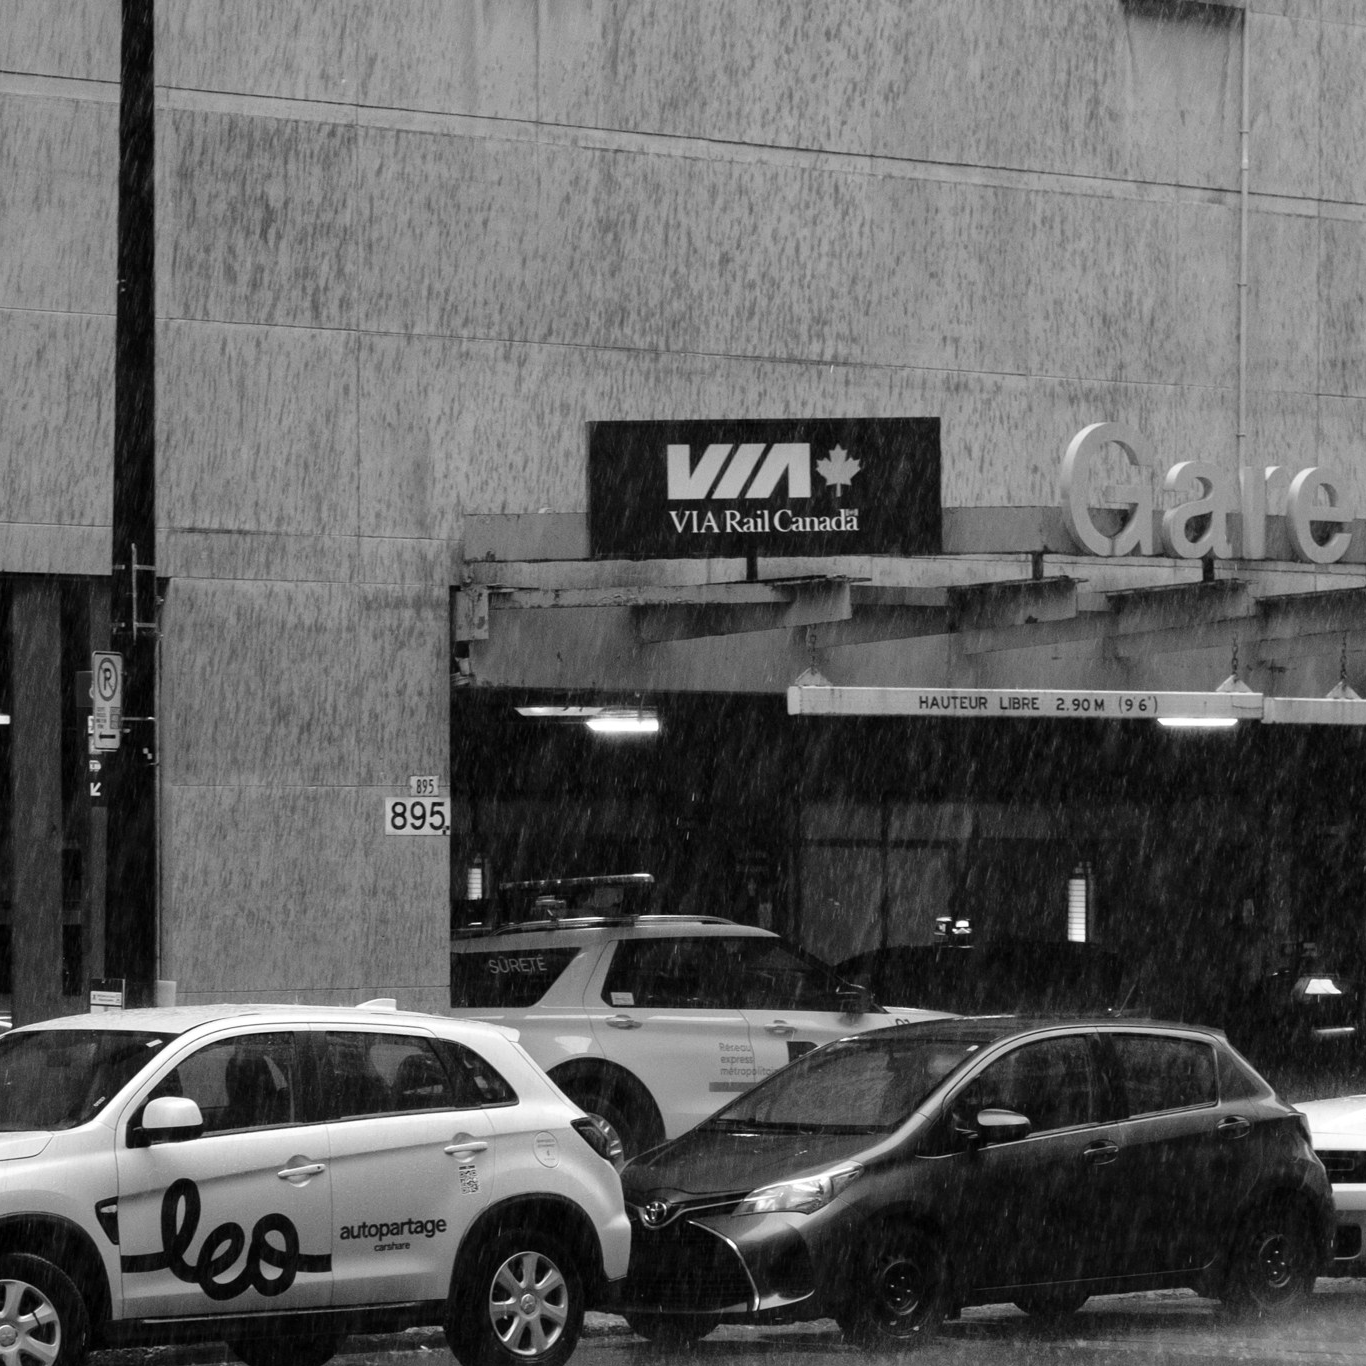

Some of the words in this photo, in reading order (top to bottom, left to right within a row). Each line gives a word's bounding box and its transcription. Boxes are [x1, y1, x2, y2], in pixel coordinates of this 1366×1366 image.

[666, 442, 812, 500] VIA
[1059, 421, 1355, 564] Gare
[669, 510, 721, 533] VIA
[724, 509, 771, 533] Rail
[773, 508, 860, 532] Canada
[918, 695, 988, 710] HAUTEUR
[999, 696, 1040, 711] LIBRE
[416, 779, 434, 794] 895
[391, 801, 445, 830] 895
[488, 953, 548, 974] SÛRETÉ
[121, 1177, 332, 1300] leo
[340, 1218, 447, 1242] autopartage
[374, 1242, 411, 1252] carshare
